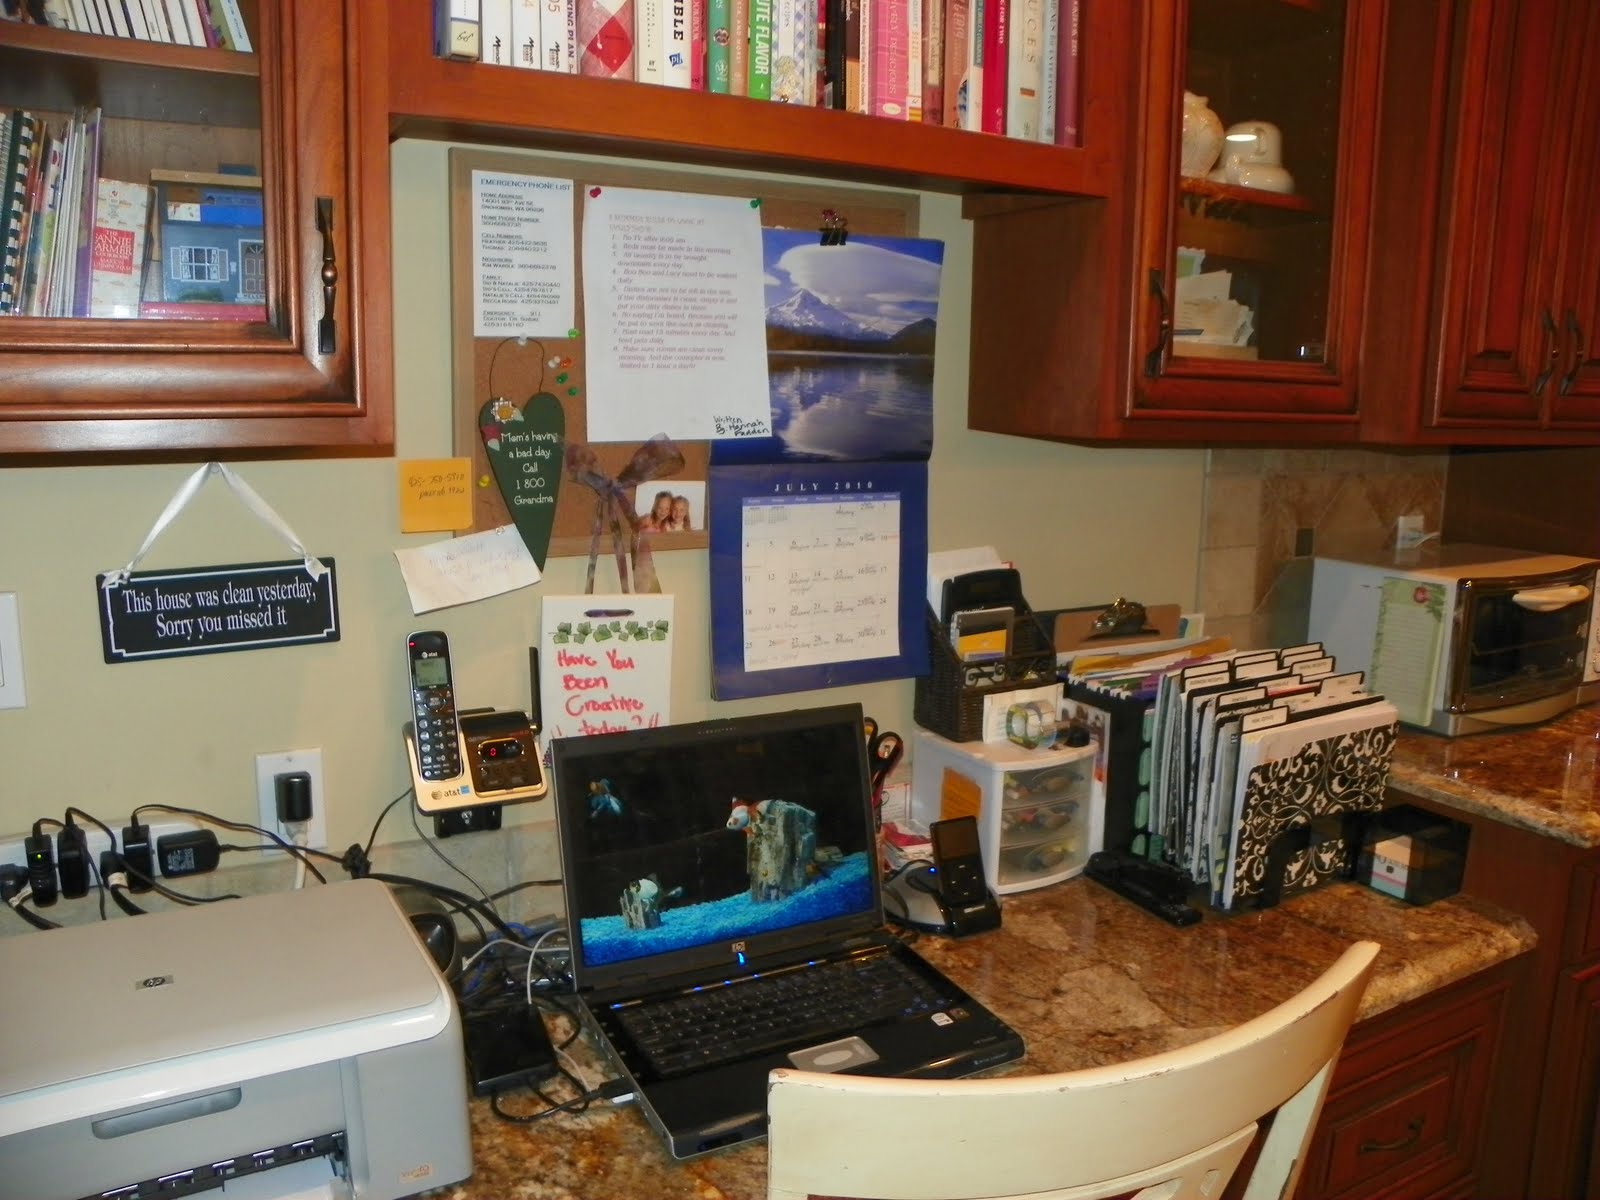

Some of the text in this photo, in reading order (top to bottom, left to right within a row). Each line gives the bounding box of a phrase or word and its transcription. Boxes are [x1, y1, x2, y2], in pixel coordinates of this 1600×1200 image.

[755, 25, 770, 75] FLAVOR
[888, 37, 898, 94] DELICIOUS
[481, 178, 527, 188] EMERGENCY
[528, 182, 552, 190] PHONE
[94, 242, 132, 256] ARMER
[500, 430, 558, 444] Mom's having
[516, 446, 532, 458] bad
[522, 462, 538, 473] Call
[524, 478, 545, 488] 800
[774, 481, 872, 492] JULY 2010
[514, 492, 554, 505] Grandma
[122, 576, 317, 613] This house was clean yesterday,
[156, 604, 288, 641] Sorry you missed it
[558, 648, 634, 670] Have You
[562, 674, 608, 690] Been
[444, 788, 461, 798] at&t
